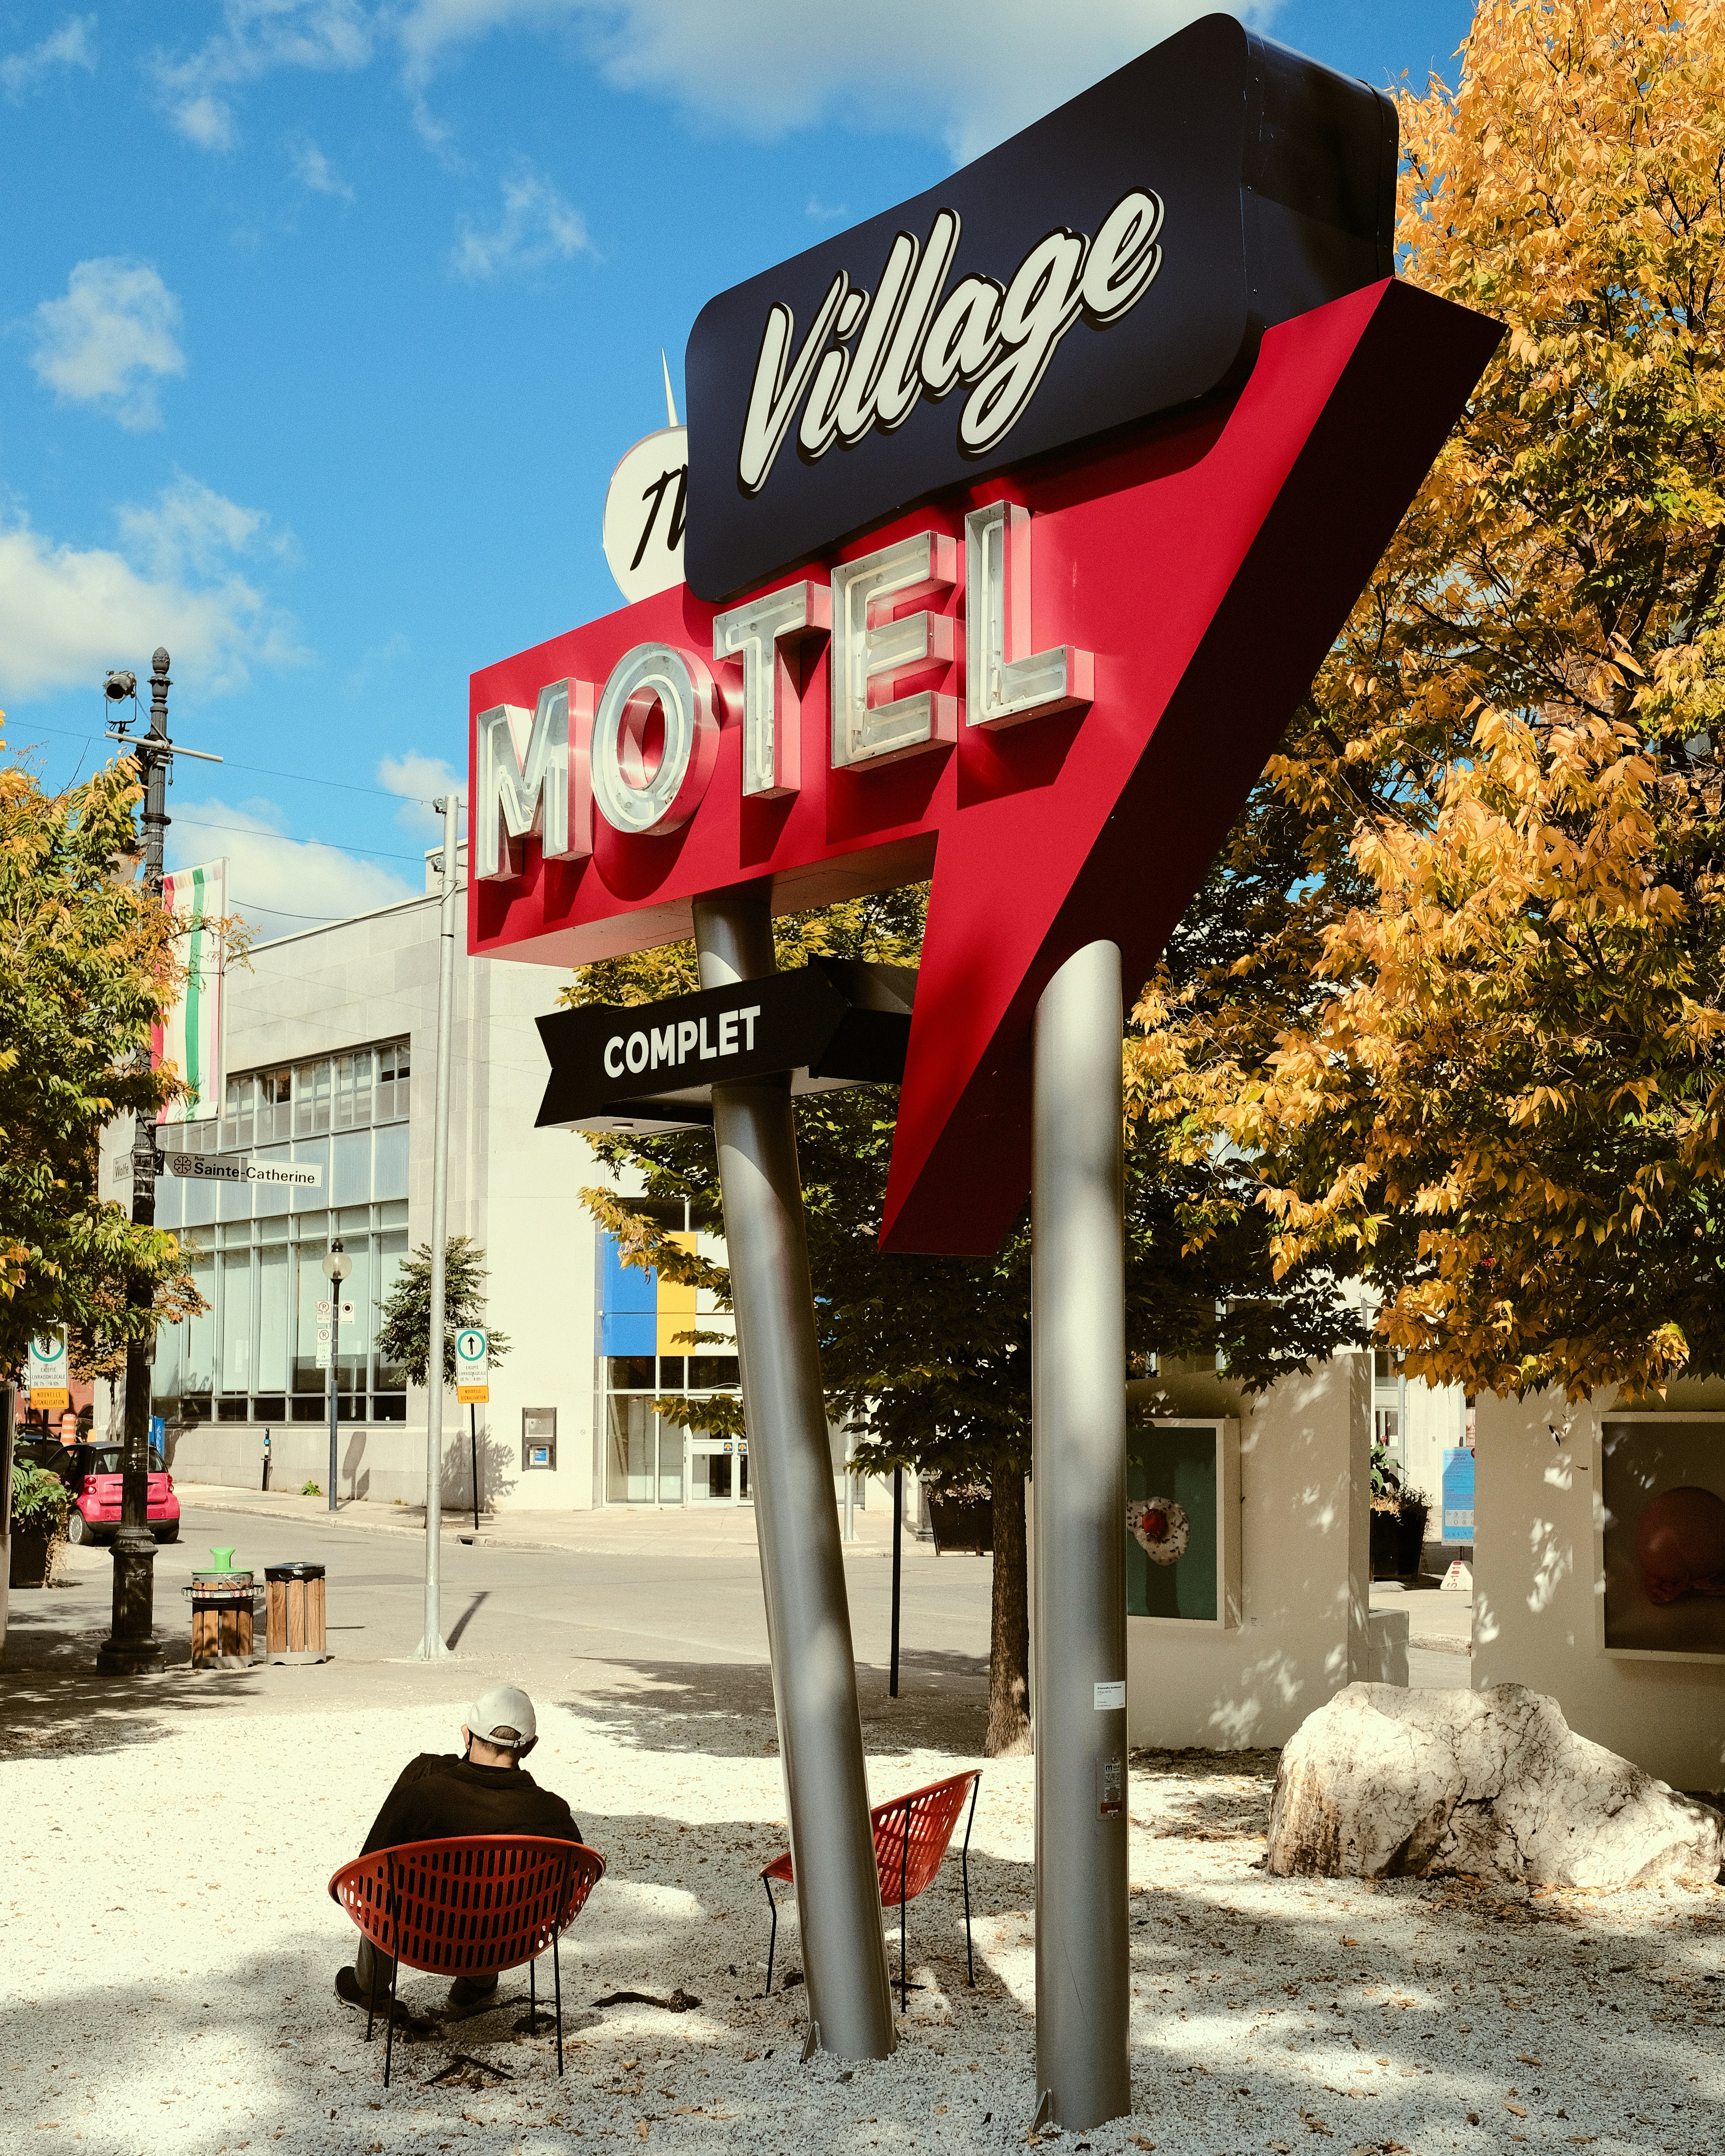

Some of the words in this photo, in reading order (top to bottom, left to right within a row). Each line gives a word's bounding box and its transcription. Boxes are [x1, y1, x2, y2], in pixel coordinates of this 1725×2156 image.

[738, 186, 1164, 493] Village
[475, 500, 1094, 881] MOTEL
[604, 1005, 760, 1078] COMPLET
[115, 1163, 129, 1177] Wolfe
[194, 1162, 315, 1183] Sainte-Catherine
